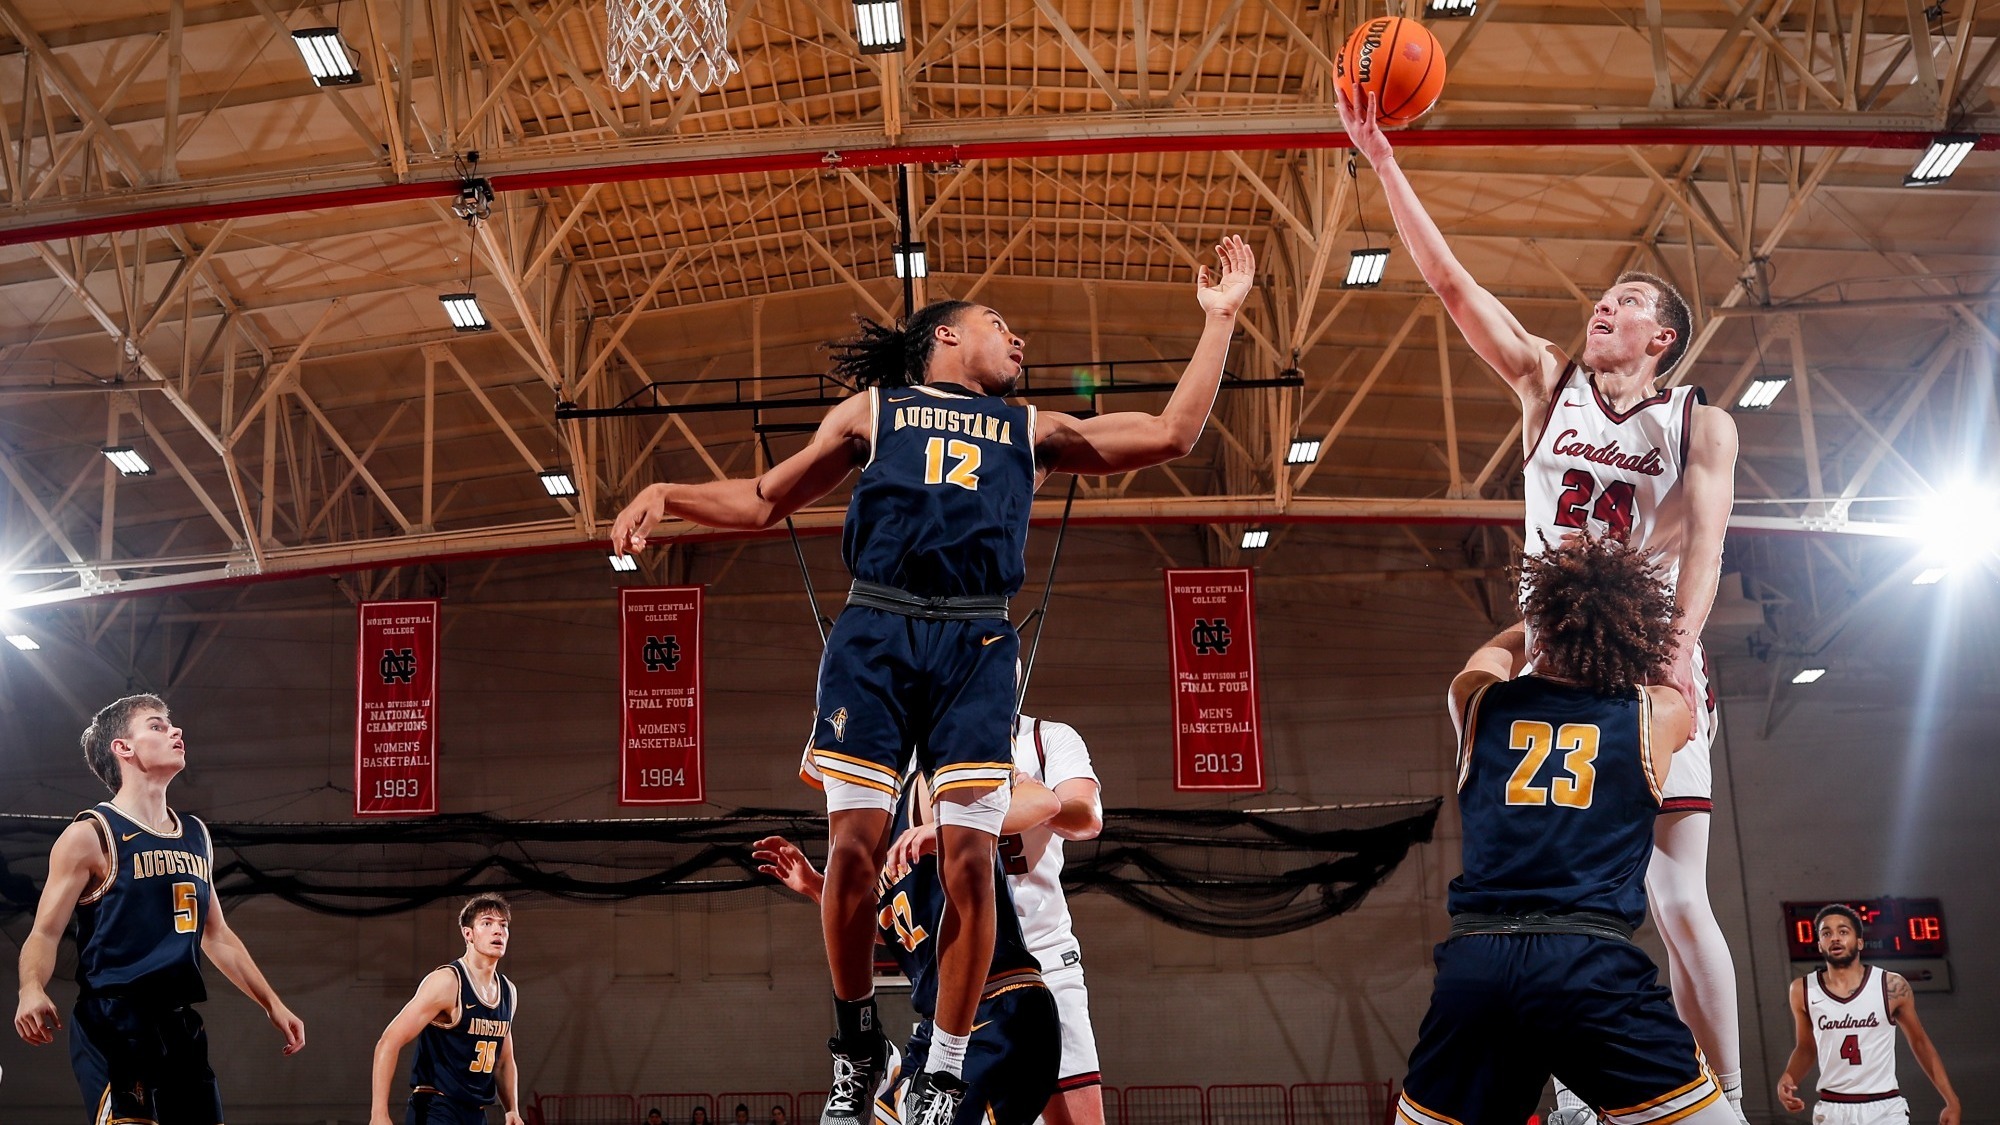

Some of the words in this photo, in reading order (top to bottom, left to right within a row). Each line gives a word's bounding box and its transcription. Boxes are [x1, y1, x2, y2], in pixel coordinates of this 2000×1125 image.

[893, 406, 1013, 445] AUGUSTANA
[1552, 428, 1665, 477] Cardinals
[924, 436, 982, 491] 12
[1553, 467, 1636, 541] 24
[1174, 586, 1202, 594] NORTH
[1205, 585, 1244, 593] CENTRAL
[1192, 596, 1227, 604] COLLEGE
[628, 604, 655, 612] NORTH
[657, 602, 695, 611] CENTRAL
[366, 617, 392, 626] NORTH
[395, 615, 431, 624] CENTRAL
[644, 614, 678, 622] COLLEGE
[382, 627, 415, 635] COLLEGE
[1179, 672, 1200, 680] NCAA
[1202, 671, 1236, 680] DIVISION
[1239, 671, 1249, 679] III
[651, 688, 684, 696] DIVISION
[1180, 682, 1215, 693] FINAL
[1219, 681, 1249, 692] FOUR
[387, 700, 418, 708] DIVISION
[629, 698, 663, 709] FINAL
[666, 697, 694, 708] FOUR
[370, 709, 424, 721] NATIONAL
[1199, 708, 1233, 719] MEN'S
[366, 720, 428, 733] CHAMPIONS
[638, 723, 686, 734] WOMEN'S
[1181, 721, 1252, 734] BASKETBALL
[374, 741, 420, 753] WOMEN'S
[628, 737, 696, 749] BASKETBALL
[362, 755, 430, 768] BASKETBALL
[1194, 753, 1243, 773] 2013
[1505, 719, 1601, 810] 23
[640, 767, 685, 787] 1984
[374, 778, 419, 799] 1983
[172, 881, 198, 934] 5
[1817, 1012, 1880, 1031] Cardinals
[1839, 1034, 1862, 1066] 4
